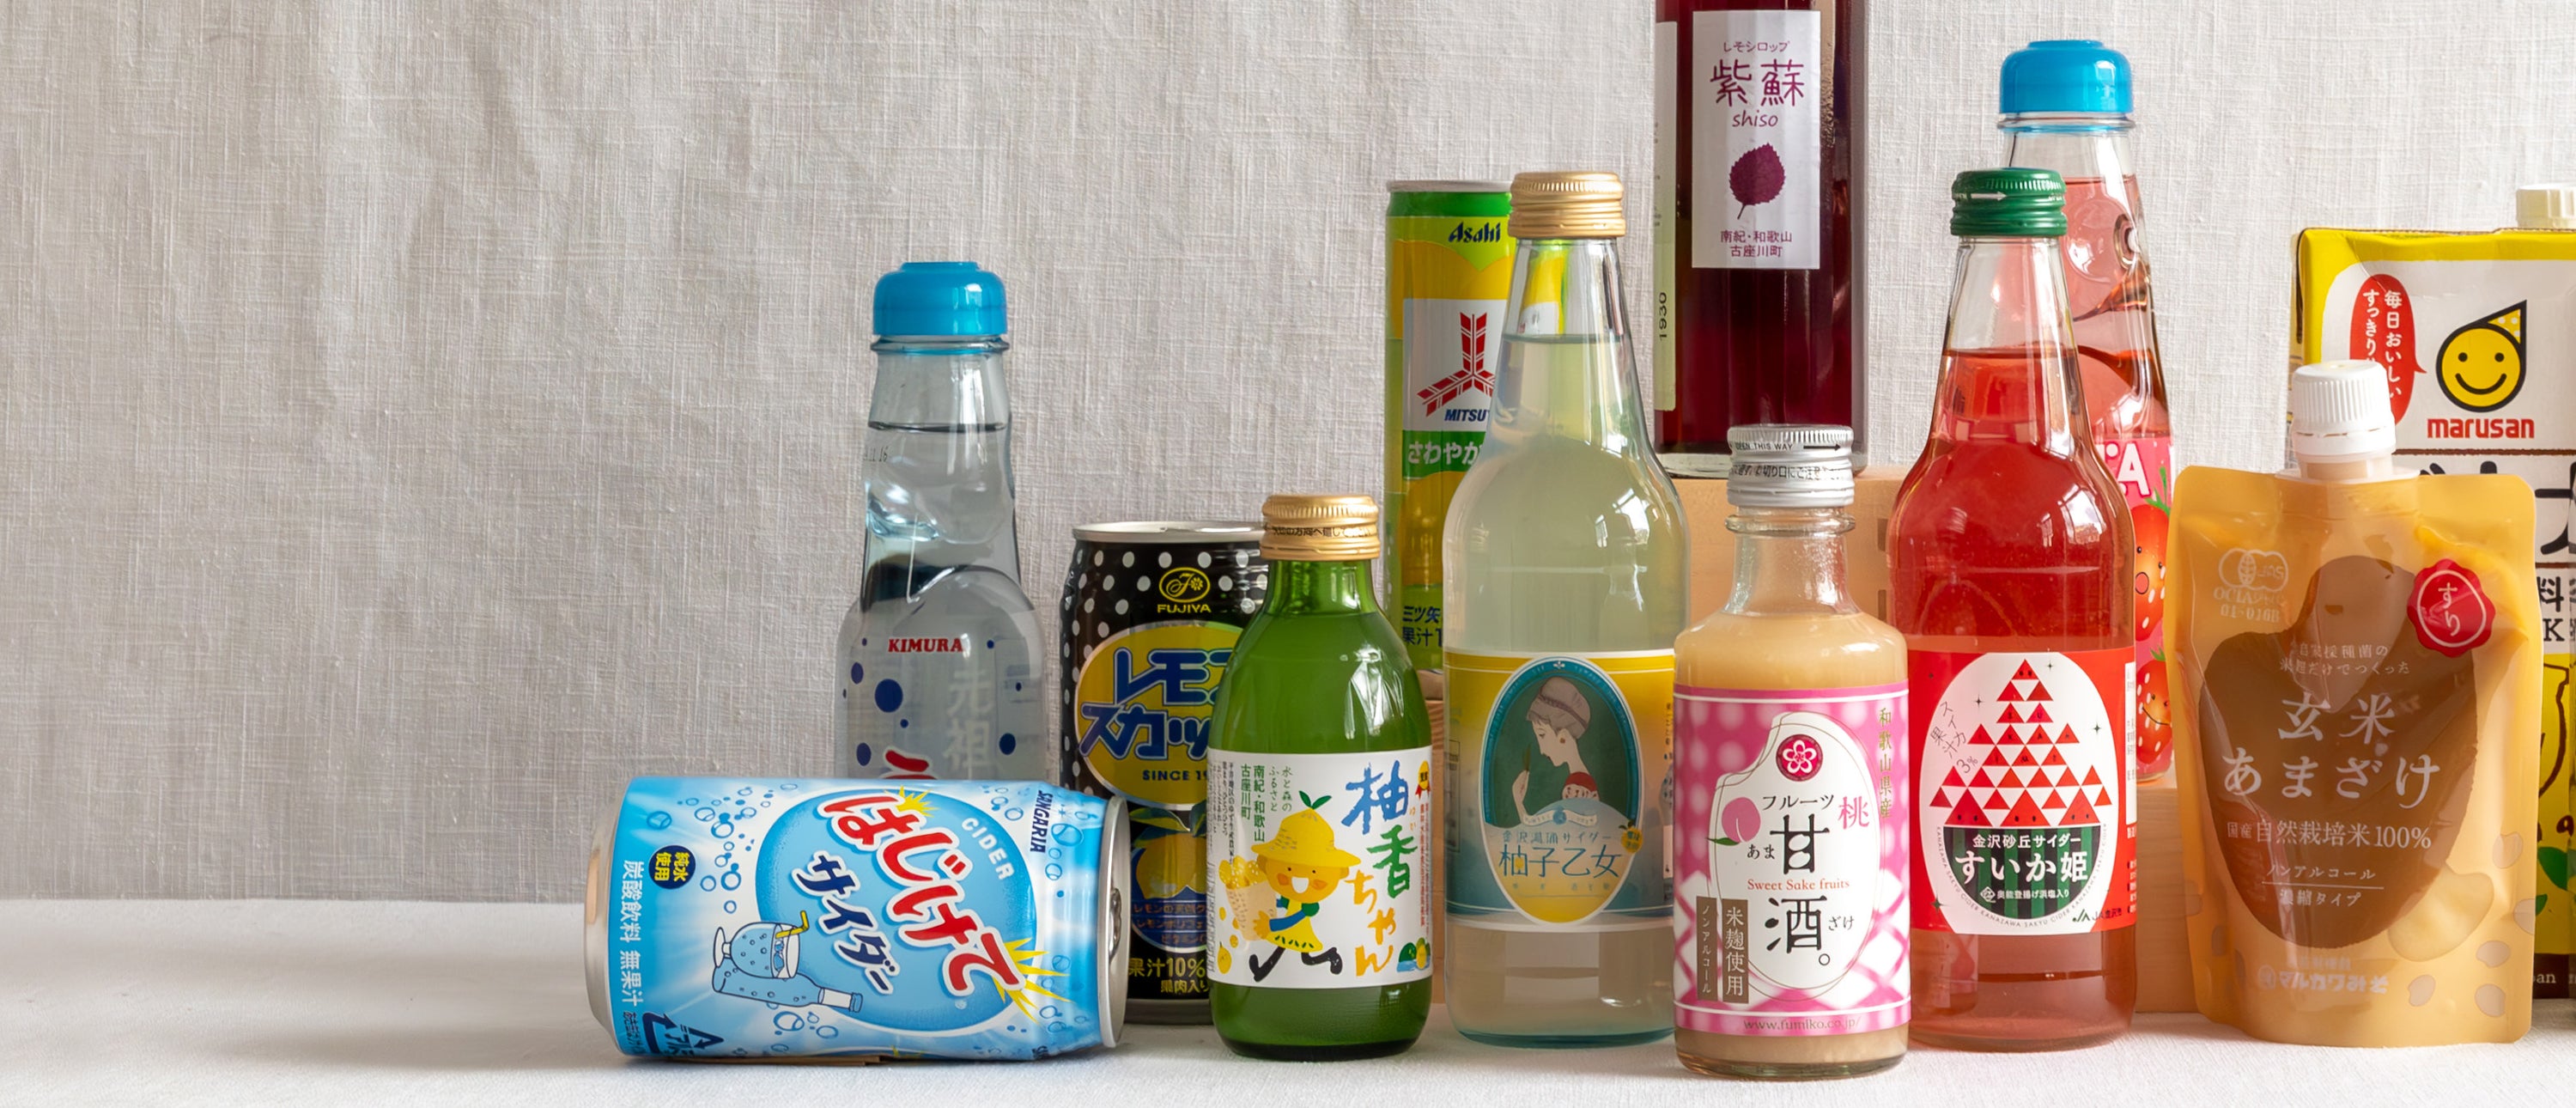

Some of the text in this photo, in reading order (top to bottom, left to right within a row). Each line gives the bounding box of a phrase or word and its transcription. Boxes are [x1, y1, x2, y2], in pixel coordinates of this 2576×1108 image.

[1722, 40, 1789, 52] しそシロップ
[1710, 58, 1805, 107] 紫蘇
[1732, 109, 1779, 127] shiso
[1448, 221, 1501, 243] Asahi
[1720, 229, 1793, 243] 南紀・和歌山
[1729, 244, 1783, 258] 古座川町
[1658, 291, 1668, 341] 1930
[2362, 289, 2380, 362] すっきり
[1443, 408, 1491, 423] MITSU
[2427, 417, 2536, 439] marusan
[1406, 441, 1481, 465] さわやか
[1754, 441, 1771, 450] THIS
[1157, 604, 1212, 614] FUJIYA
[887, 637, 965, 654] KIMURA
[2276, 691, 2396, 746] 玄米
[1878, 707, 1893, 819] 和歌山県産
[1141, 769, 1190, 782] SINCE
[2221, 746, 2441, 810] あまざけ
[1240, 763, 1252, 820] 古座川町
[1761, 794, 1835, 811] フルーツ
[1029, 789, 1049, 854] SANGARIA
[1837, 795, 1871, 830] 桃
[961, 817, 1014, 882] CIDER
[1747, 844, 1776, 861] あま
[1971, 833, 2081, 849] 金沢砂丘サイダー
[1498, 843, 1623, 879] 柚子乙女
[1954, 849, 2088, 885] すいか姫
[1747, 878, 1850, 891] Sweet Sake fruits
[2266, 865, 2377, 881] ノンアルコール
[819, 795, 1024, 995] はじけて
[793, 849, 894, 994] サイダー
[1827, 915, 1856, 931] ざけ
[618, 860, 645, 1008] 炭酸飲料 無果汁
[1701, 905, 1711, 995] ノンアルコール
[1725, 905, 1746, 997] 米麹使用
[1127, 956, 1205, 978] 果汁10%
